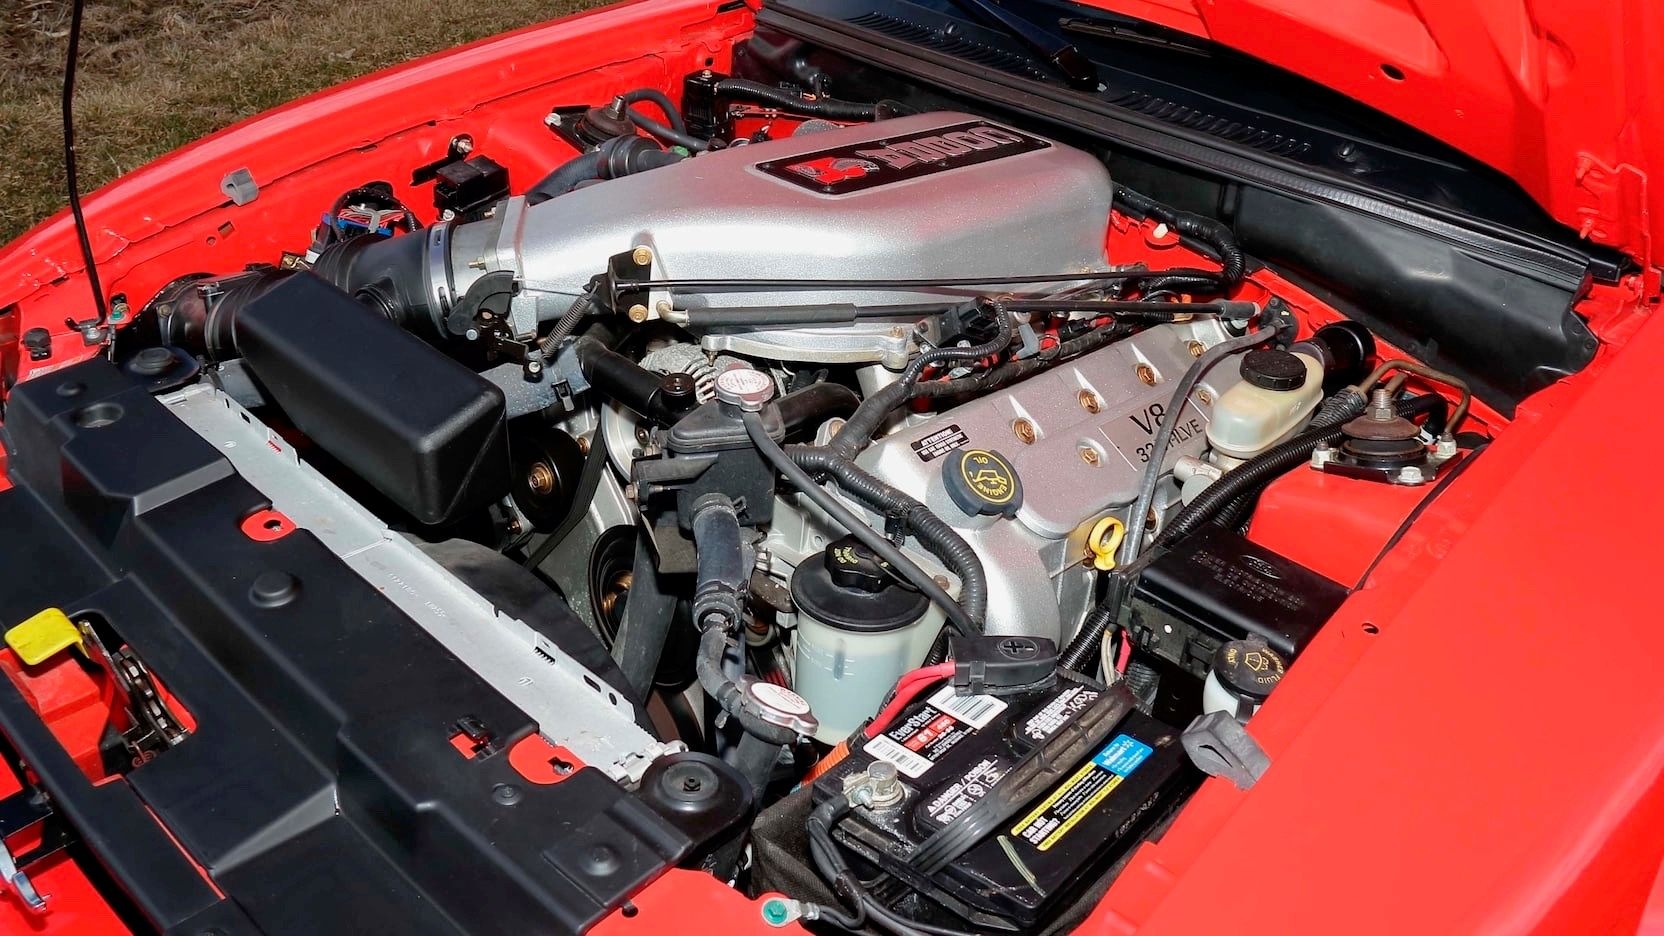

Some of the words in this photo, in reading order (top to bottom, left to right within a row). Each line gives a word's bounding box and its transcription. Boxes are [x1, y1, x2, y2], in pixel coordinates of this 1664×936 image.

[1129, 403, 1165, 435] V8
[973, 456, 989, 465] OIL
[977, 482, 1008, 496] ENGINE
[889, 706, 938, 741] EverStart
[932, 783, 964, 809] DANGER
[964, 759, 992, 781] POISON
[1022, 825, 1038, 839] CAR
[1033, 815, 1048, 830] NOT
